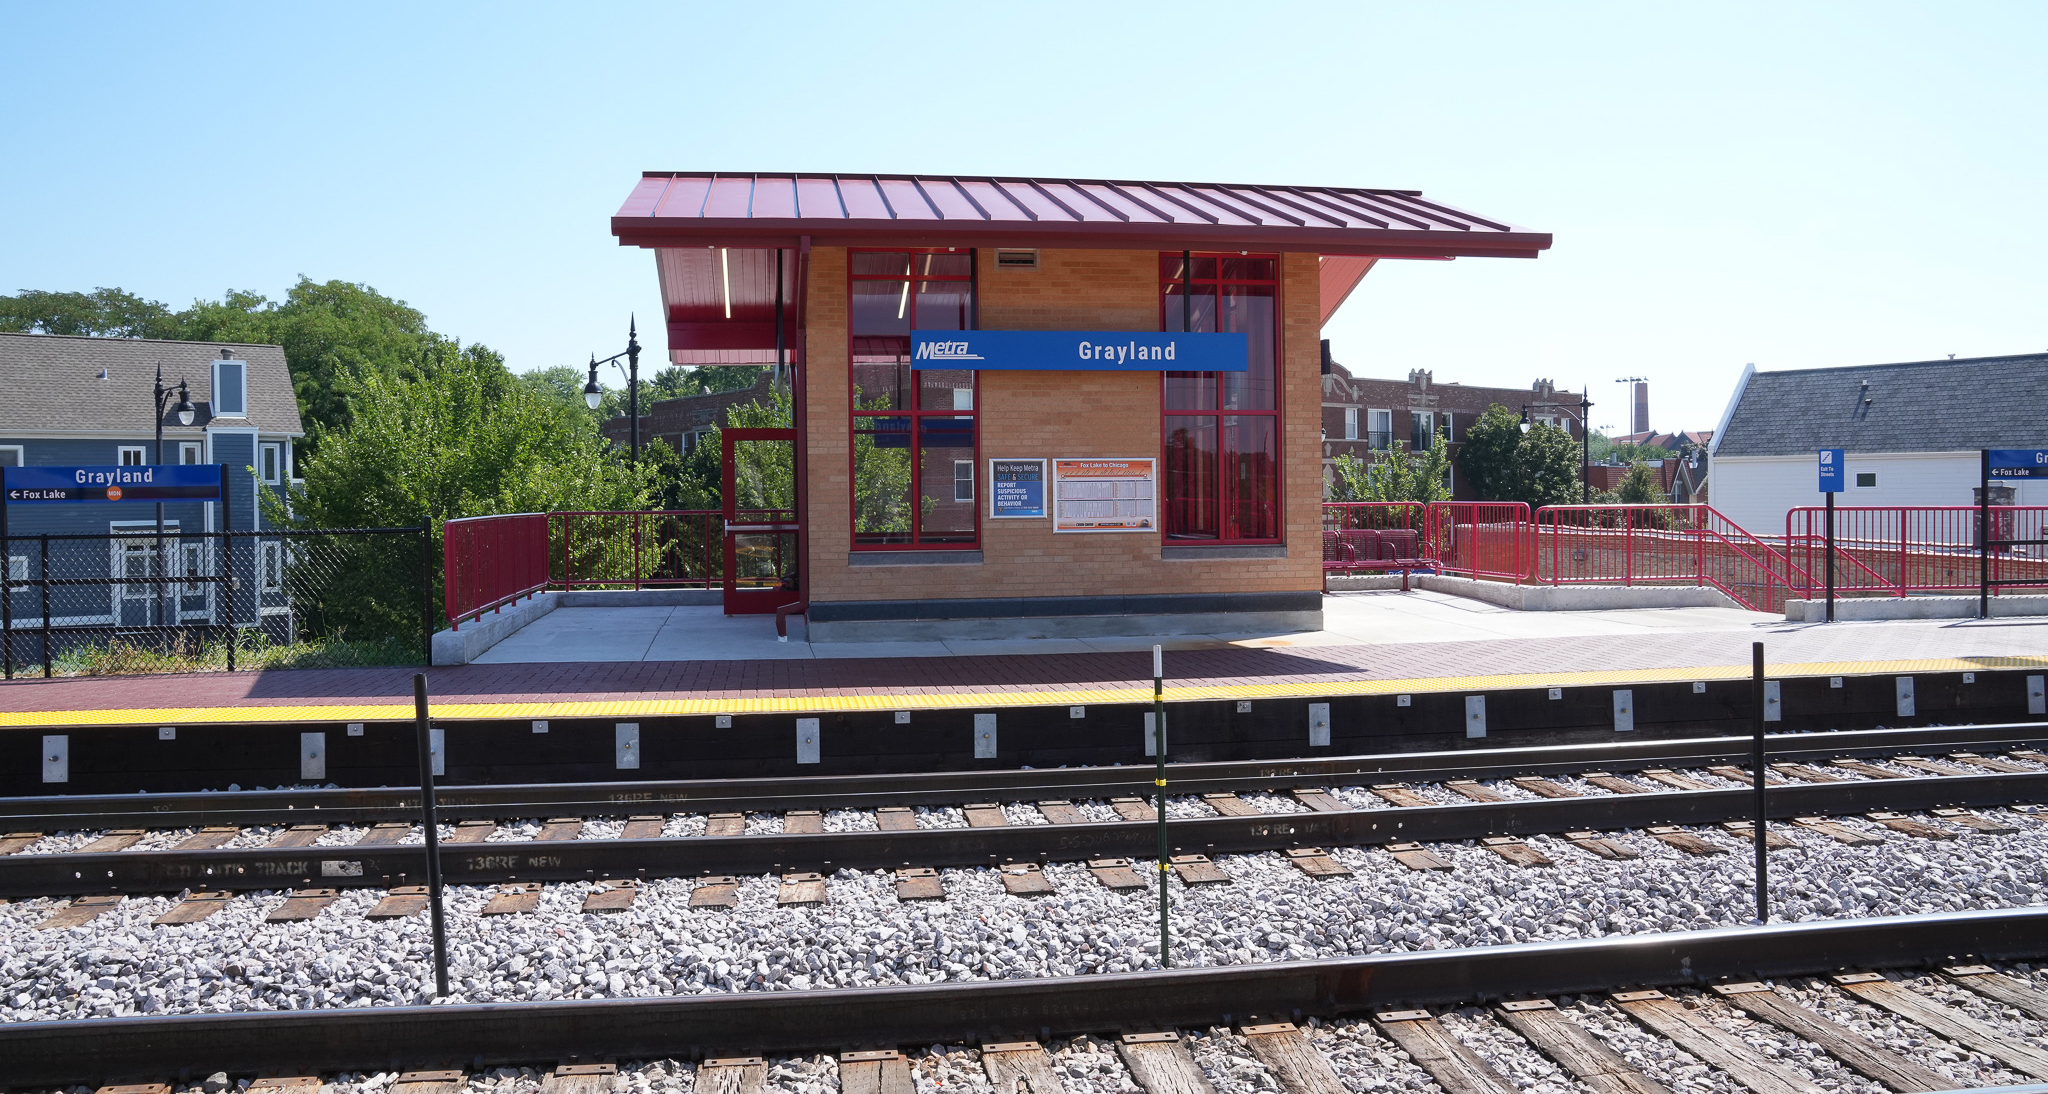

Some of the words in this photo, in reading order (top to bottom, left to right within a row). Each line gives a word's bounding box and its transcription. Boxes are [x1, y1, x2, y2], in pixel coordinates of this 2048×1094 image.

[915, 340, 969, 360] Metra
[1078, 341, 1176, 365] Grayland
[997, 464, 1009, 473] Help
[1010, 464, 1023, 473] Keep
[1023, 464, 1039, 472] Metra
[2000, 468, 2013, 476] Fox
[2013, 468, 2030, 476] Lake
[75, 468, 153, 487] Grayland
[997, 473, 1011, 481] SAFE
[1012, 473, 1017, 481] &
[1017, 473, 1039, 481] SECURE
[23, 490, 41, 499] Fox
[43, 490, 66, 499] Lake
[528, 856, 562, 868] NEW
